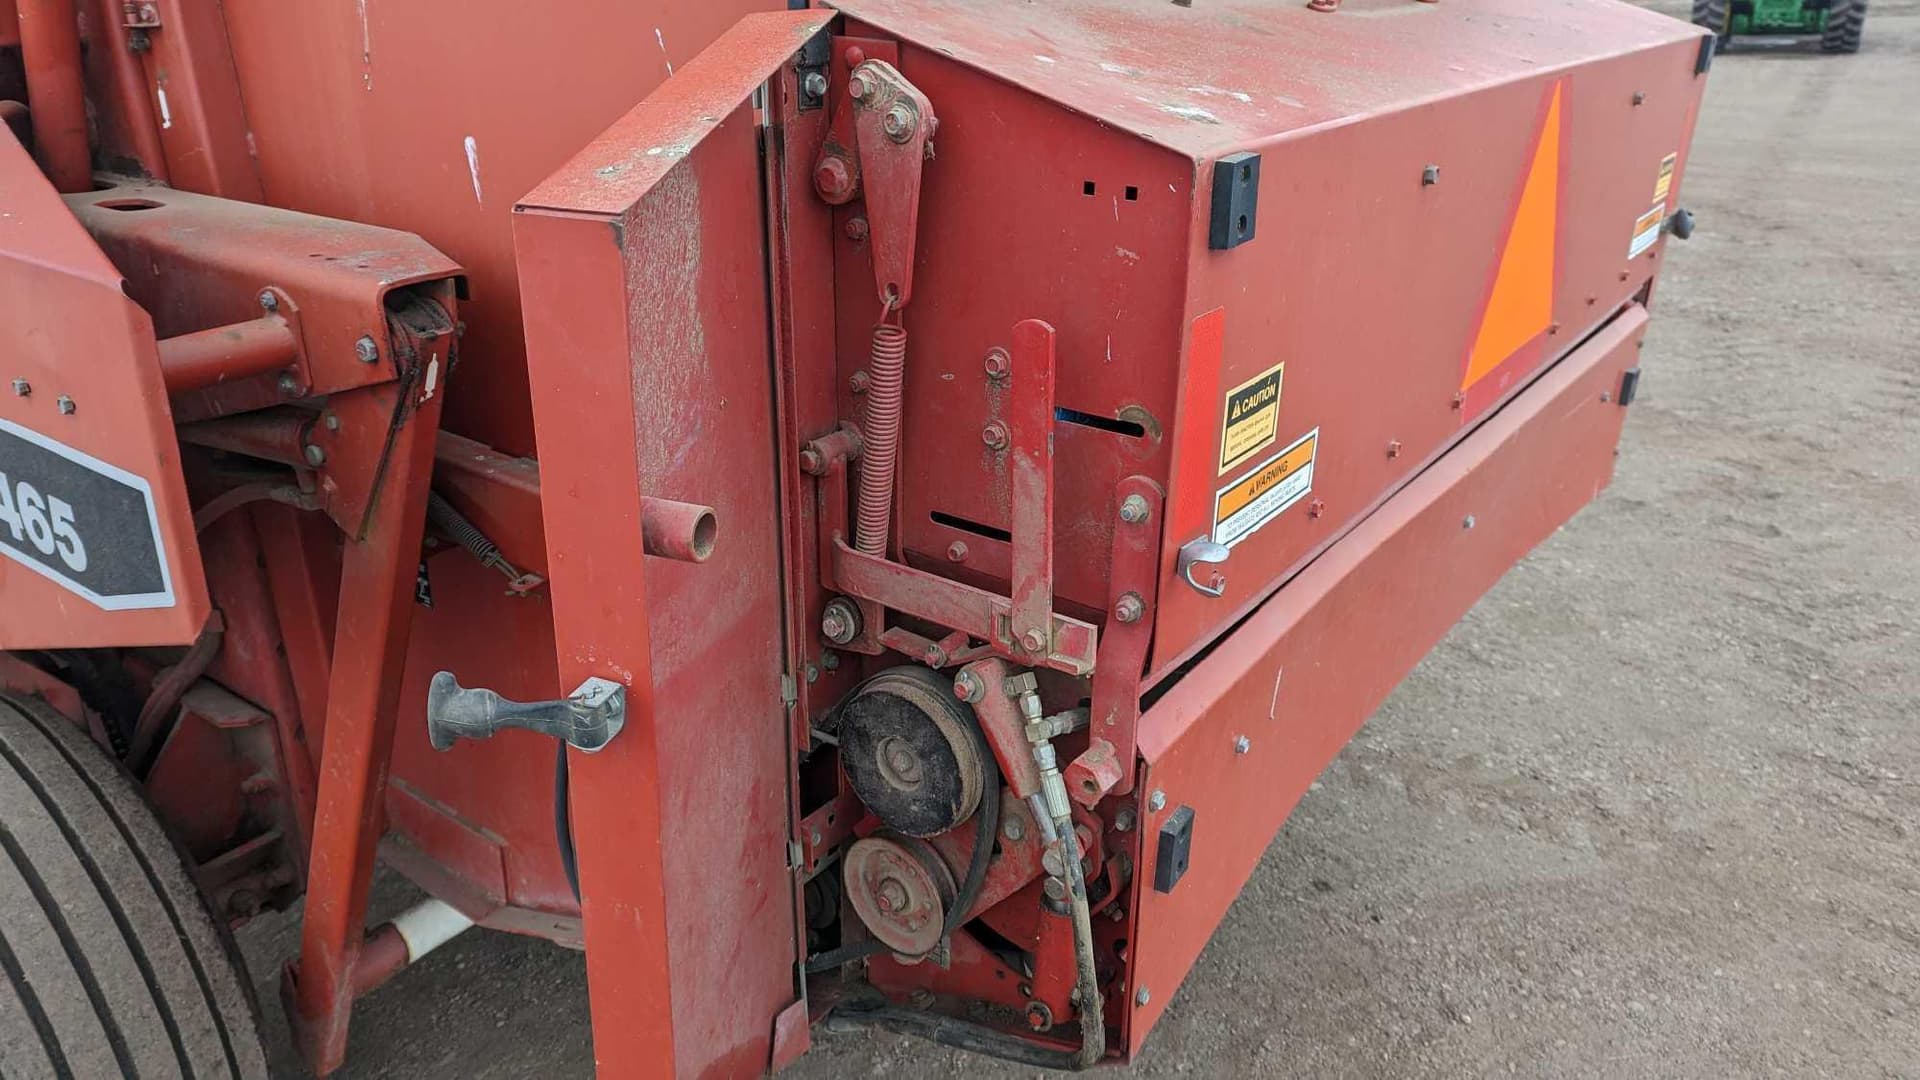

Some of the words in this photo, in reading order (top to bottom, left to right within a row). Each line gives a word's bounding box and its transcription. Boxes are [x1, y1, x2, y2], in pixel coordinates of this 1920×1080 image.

[1242, 383, 1276, 413] CAUTION
[1255, 460, 1288, 491] WARNING
[0, 471, 87, 572] 465
